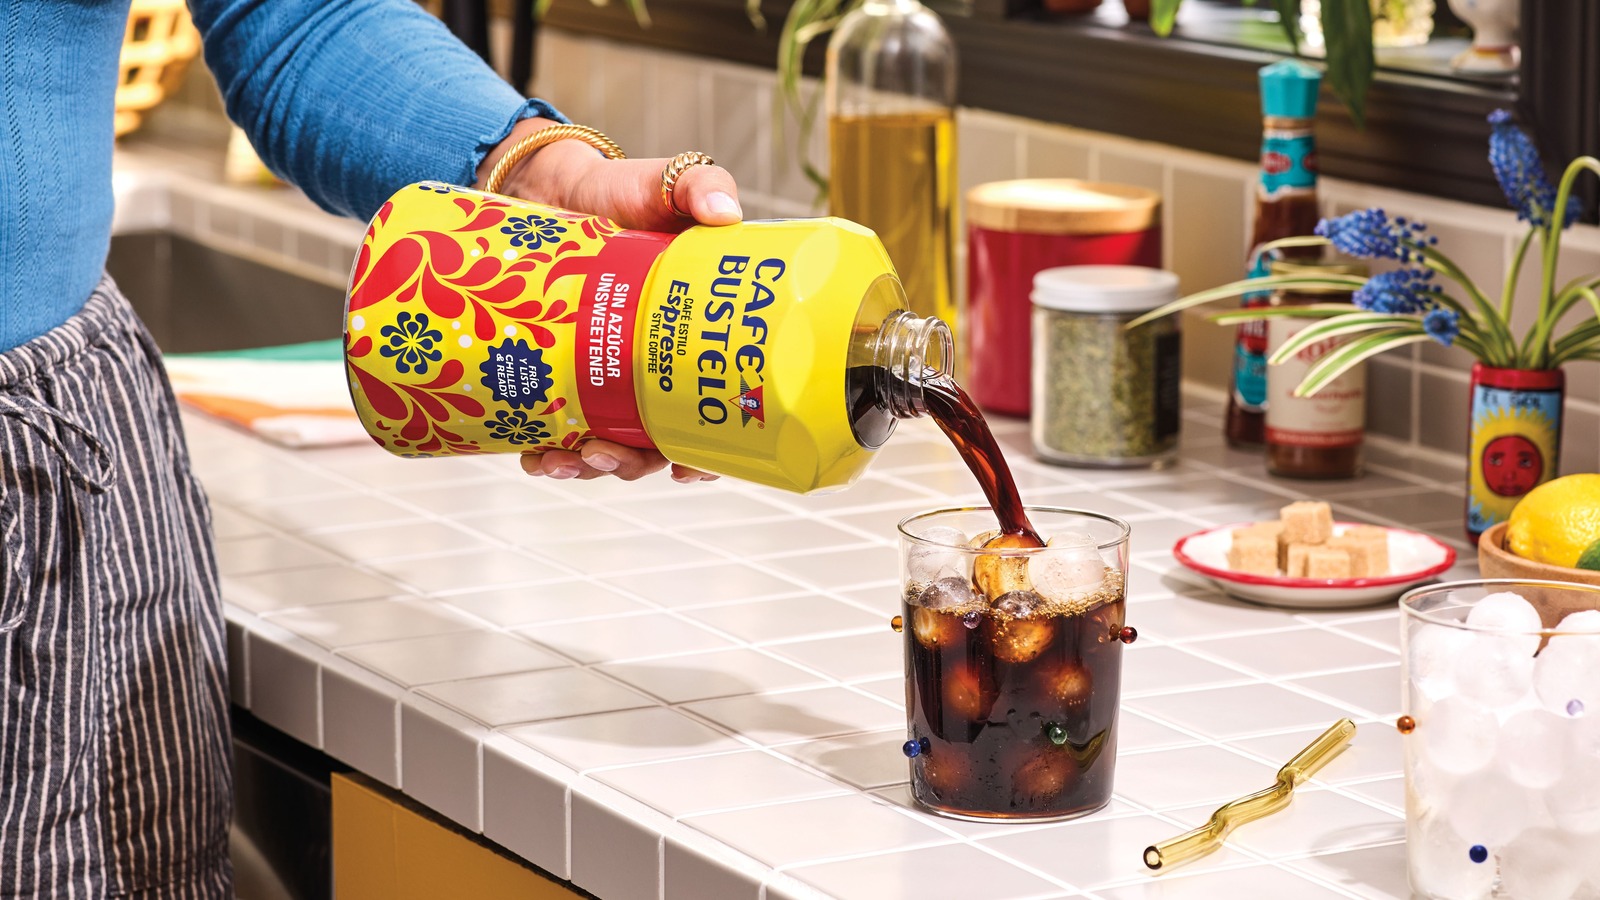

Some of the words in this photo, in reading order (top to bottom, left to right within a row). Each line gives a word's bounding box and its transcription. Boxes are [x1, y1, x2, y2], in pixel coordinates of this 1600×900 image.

[611, 283, 630, 308] SIN
[680, 298, 694, 321] CAFÉ
[589, 273, 616, 387] UNSWEETENED
[649, 312, 662, 340] STYLE
[659, 280, 690, 392] Espresso
[676, 323, 689, 356] ESTILO
[697, 255, 750, 425] BUSTELO
[496, 353, 505, 362] &
[606, 313, 624, 378] AZÚCAR
[647, 341, 659, 374] COFFEE
[496, 364, 509, 398] READY
[505, 354, 518, 398] CHILLED
[519, 366, 531, 395] LISTO
[528, 365, 539, 389] FRÍO
